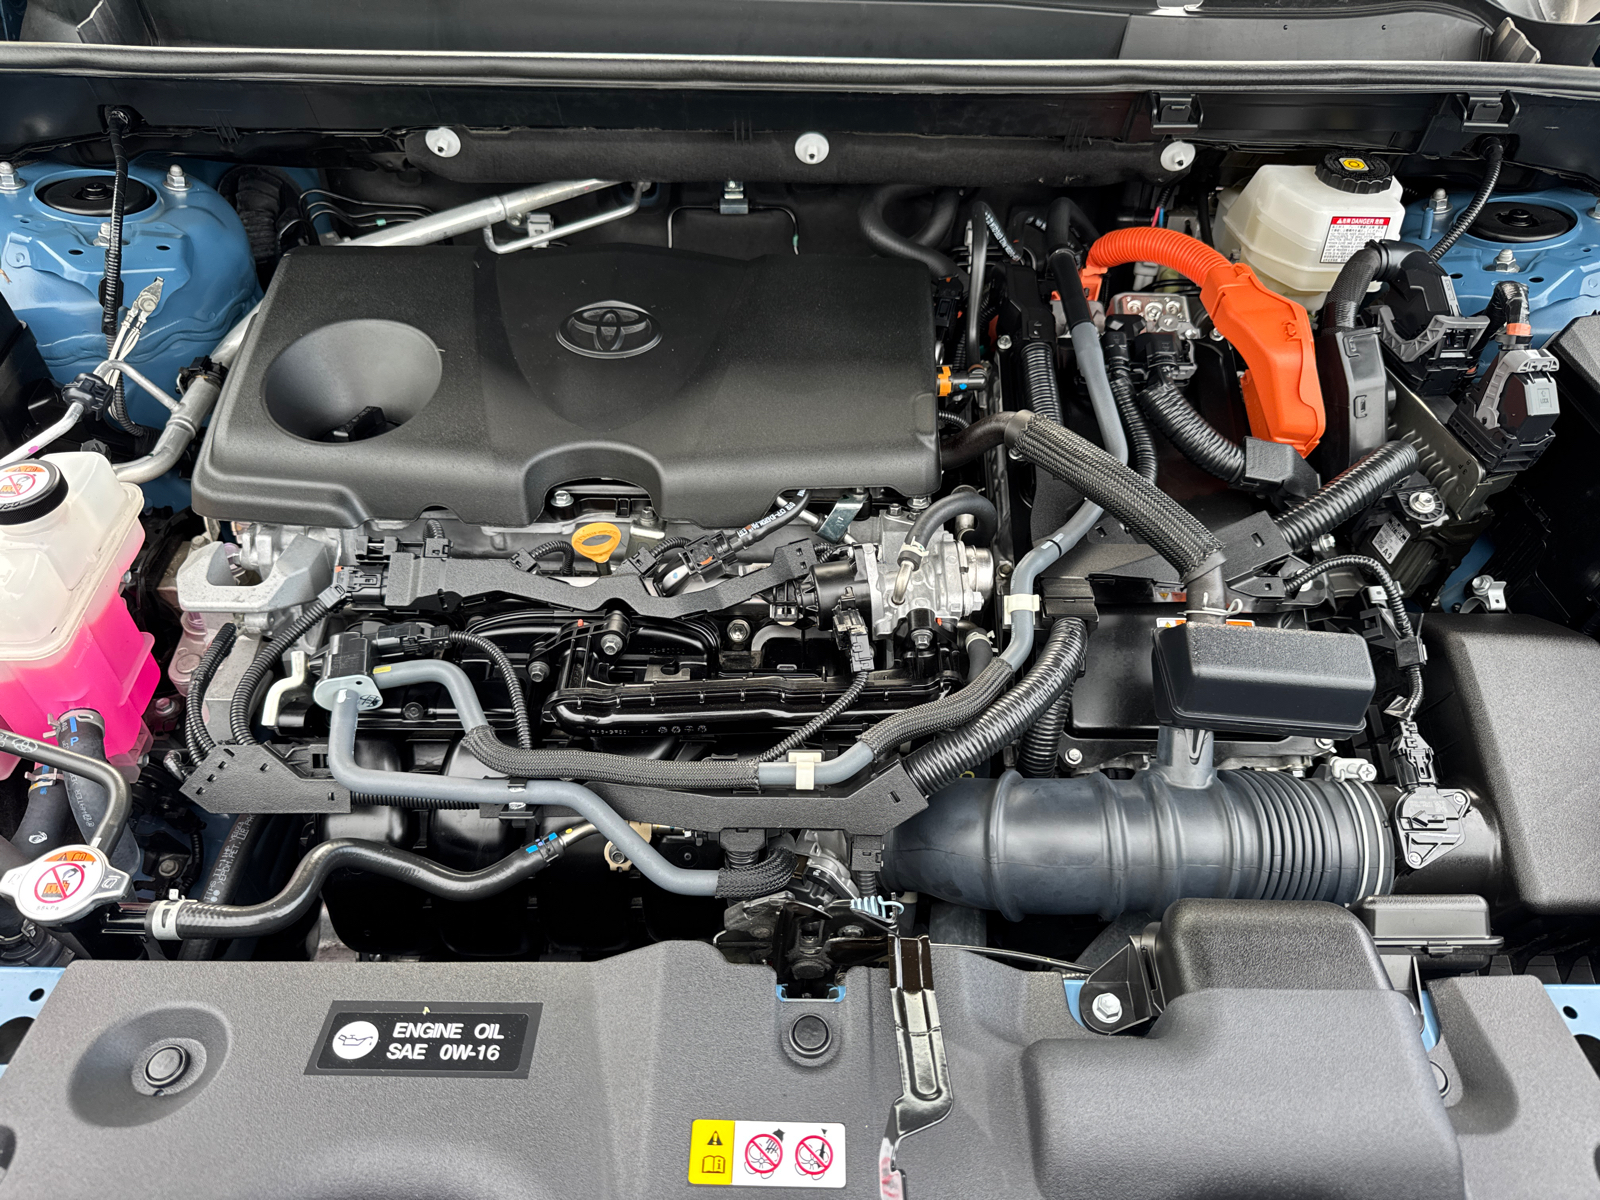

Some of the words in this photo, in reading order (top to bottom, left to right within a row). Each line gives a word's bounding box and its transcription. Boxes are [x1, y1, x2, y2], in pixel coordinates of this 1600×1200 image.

[70, 736, 79, 747] P
[392, 1022, 464, 1039] ENGINE
[474, 1023, 505, 1040] OIL
[386, 1043, 429, 1060] SAE
[439, 1044, 501, 1061] 0W-16
